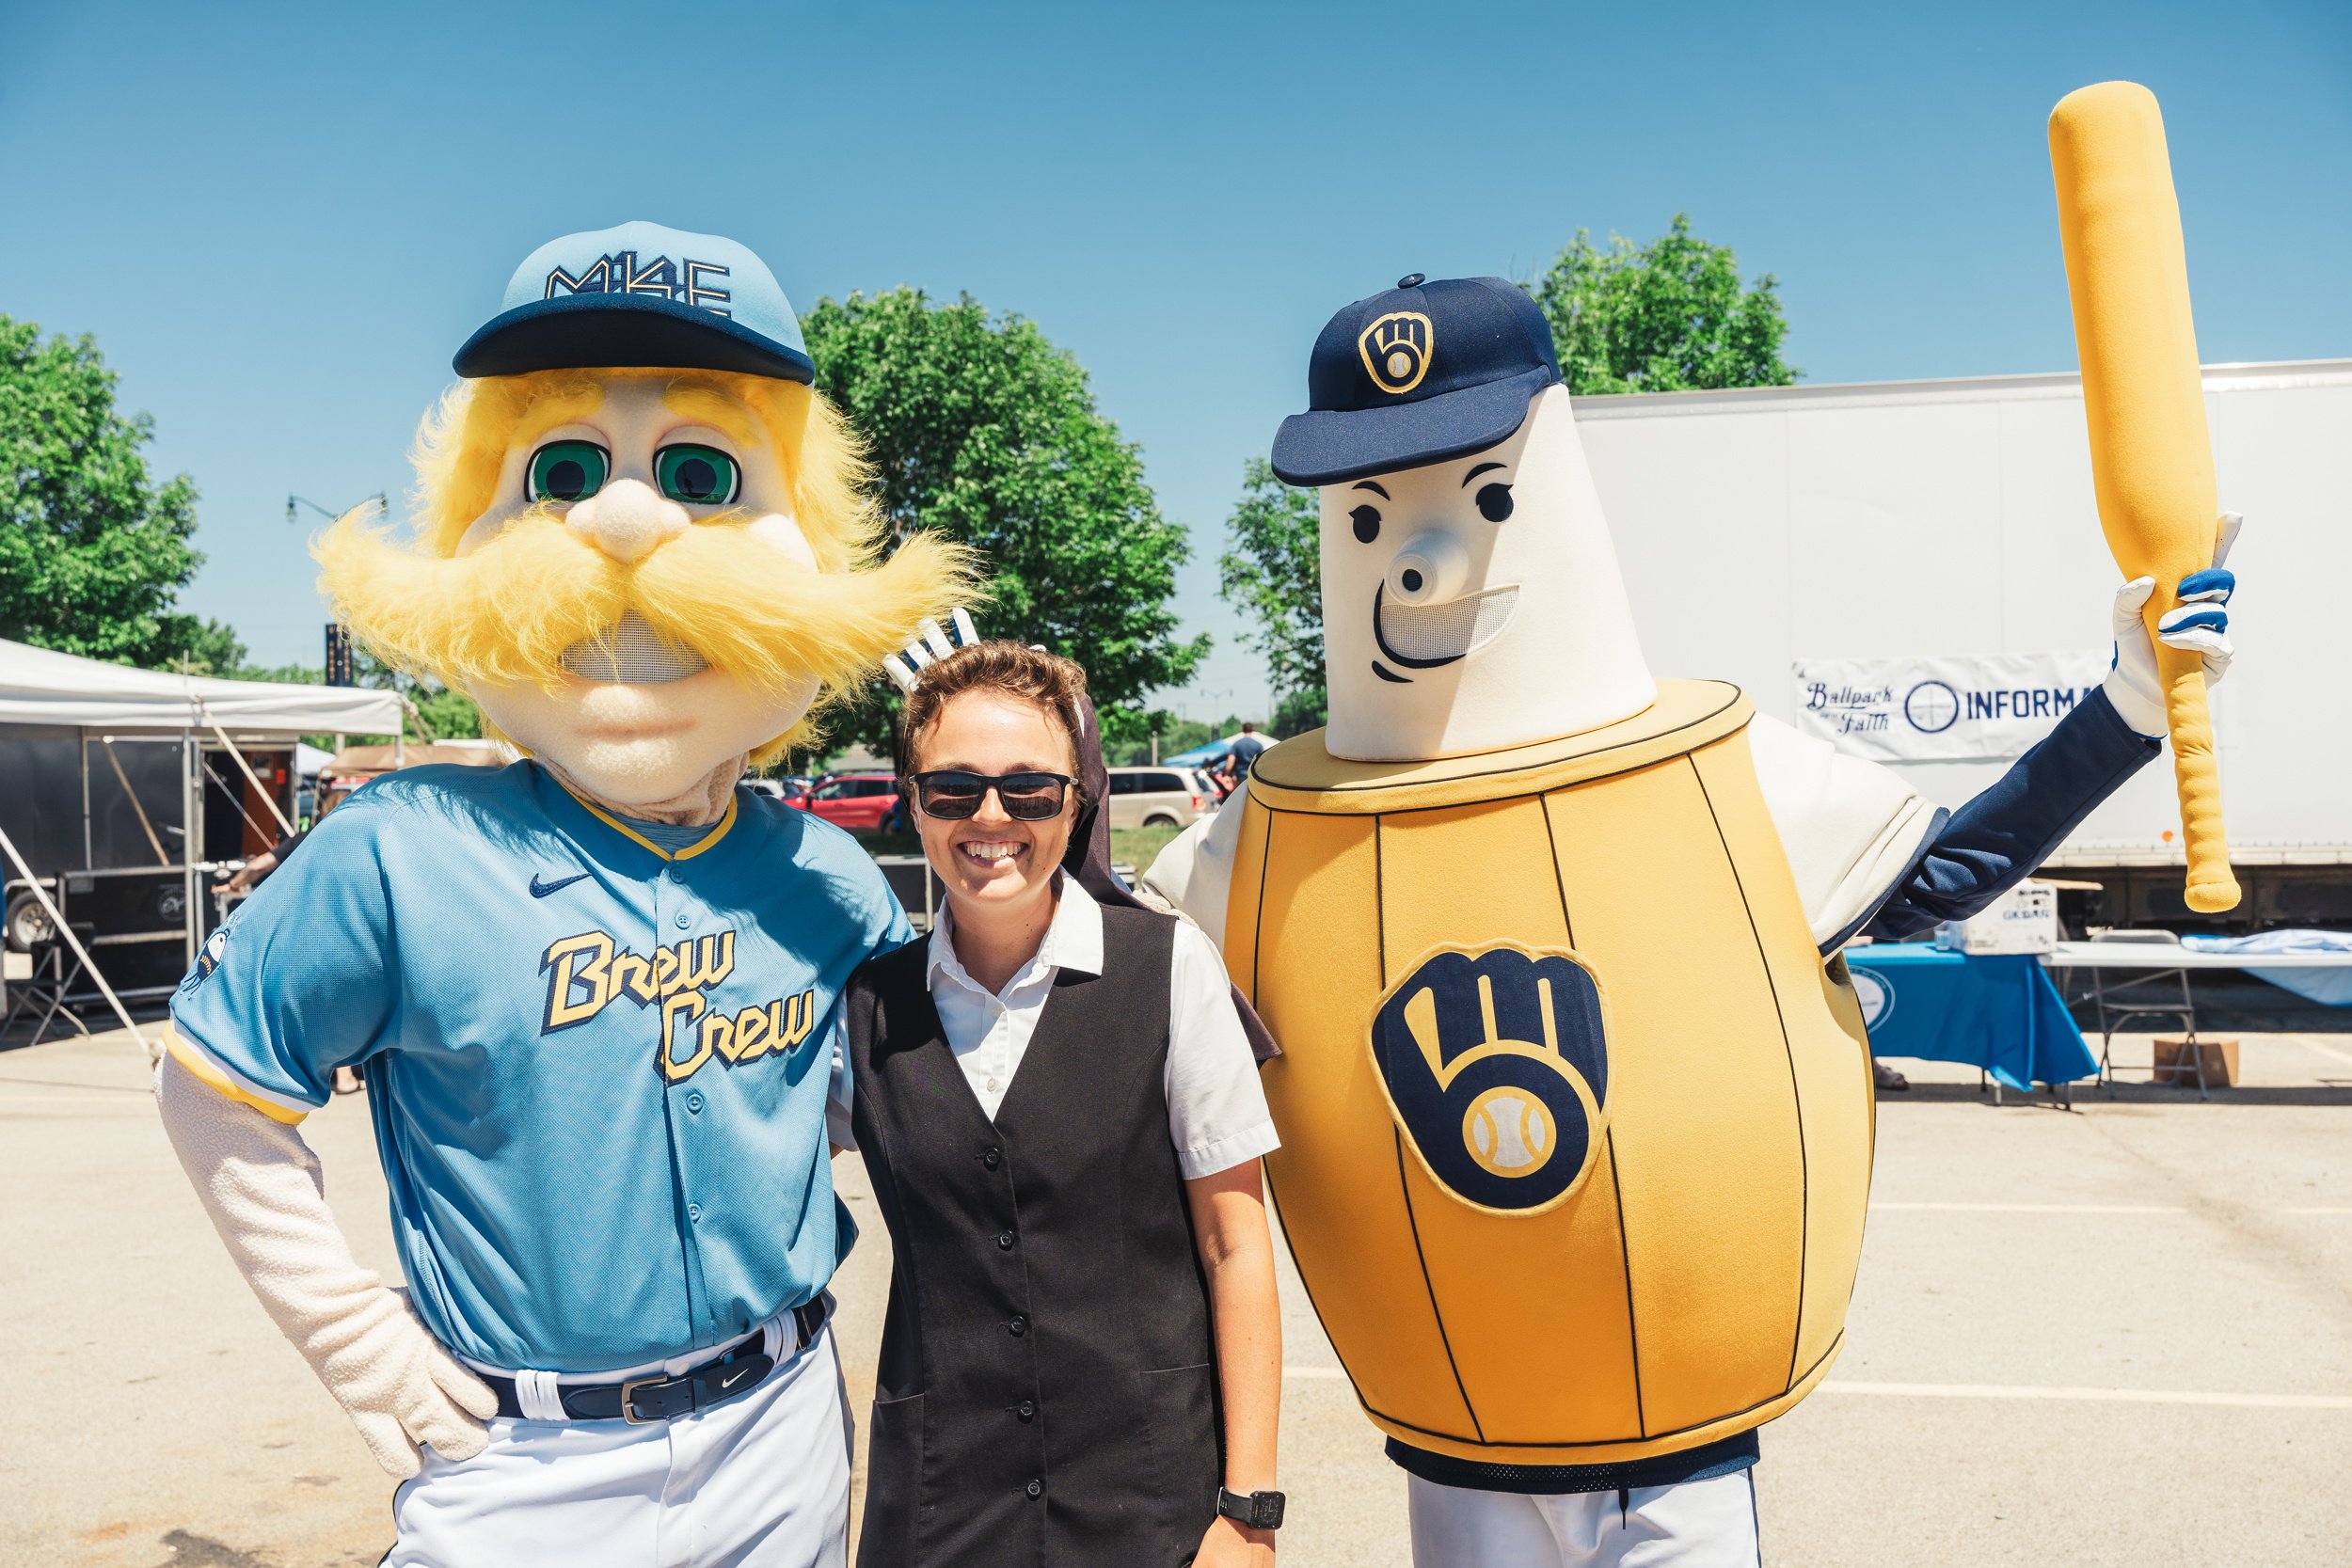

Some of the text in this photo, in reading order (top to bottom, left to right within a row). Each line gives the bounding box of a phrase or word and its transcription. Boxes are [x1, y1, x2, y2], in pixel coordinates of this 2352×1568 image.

[544, 250, 732, 321] MKE
[1806, 682, 1893, 710] Ballpark
[1837, 712, 1889, 735] Faith
[538, 928, 737, 1037] Brew
[652, 988, 815, 1087] Crew
